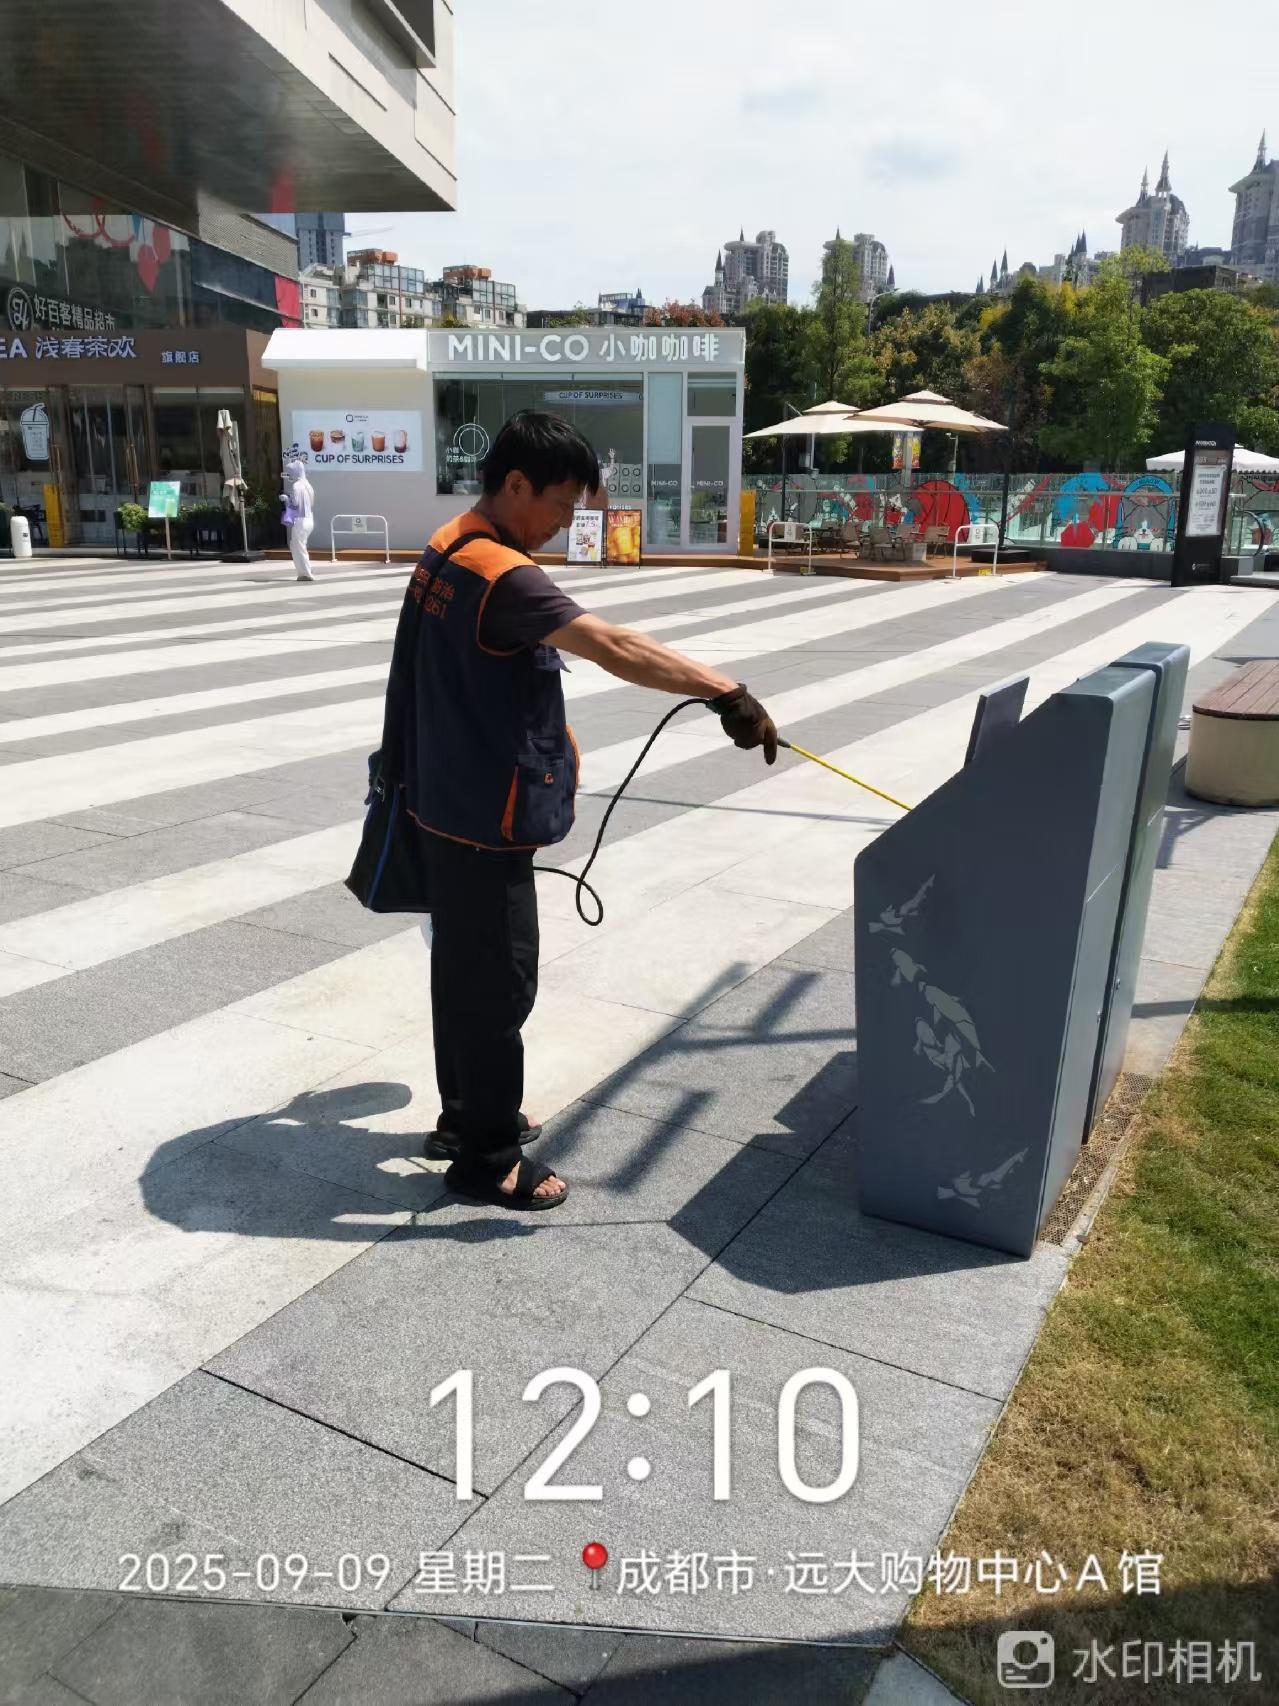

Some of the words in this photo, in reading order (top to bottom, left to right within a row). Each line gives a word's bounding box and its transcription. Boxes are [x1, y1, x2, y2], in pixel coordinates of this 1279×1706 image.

[35, 336, 137, 359] 浅春茶欢
[447, 334, 590, 362] MINI-CO
[598, 333, 720, 362] 小咖咖啡
[161, 351, 200, 364] 旗舰店
[584, 391, 623, 399] SURPRISES
[314, 454, 335, 464] CUP
[336, 454, 351, 464] OF
[351, 454, 404, 464] SURPRISES
